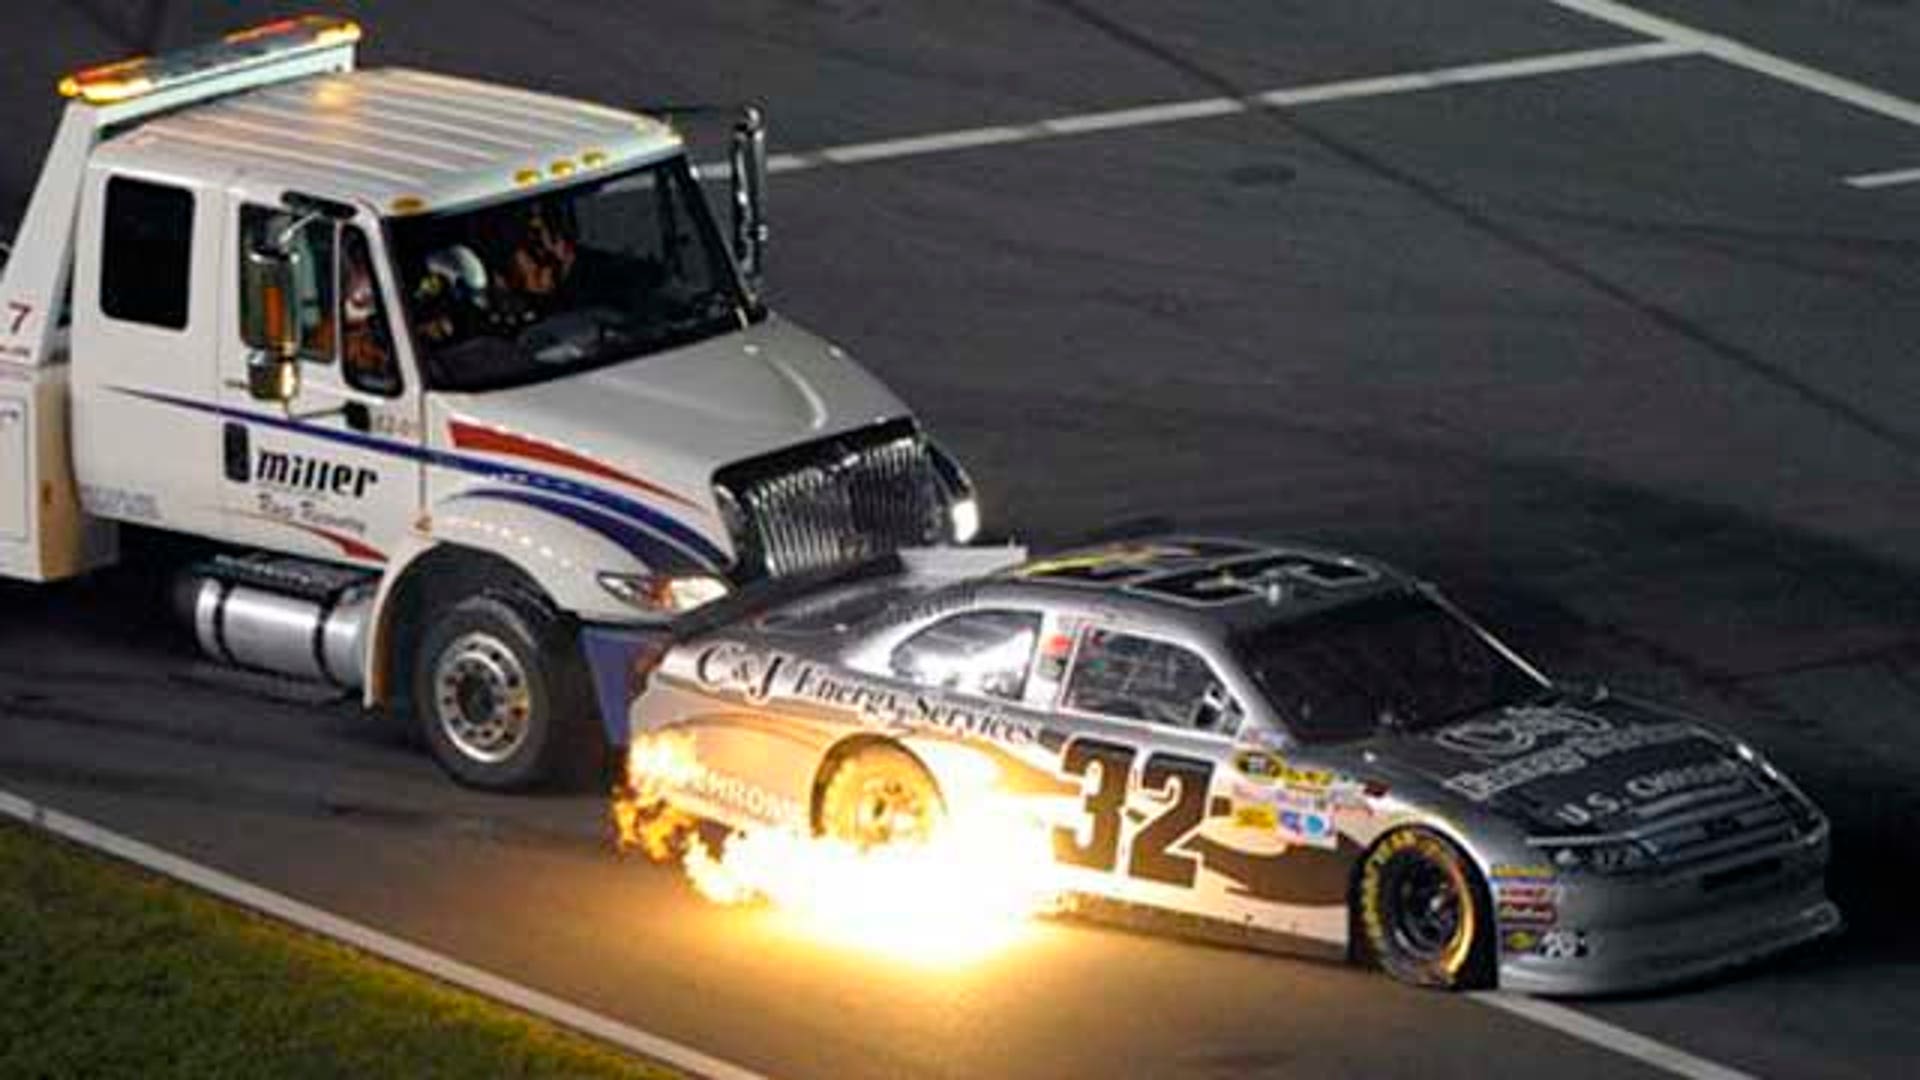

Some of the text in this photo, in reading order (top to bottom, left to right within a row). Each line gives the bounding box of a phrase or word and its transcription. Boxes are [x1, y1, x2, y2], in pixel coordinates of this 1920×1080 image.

[256, 451, 379, 498] miller
[795, 665, 905, 720] Energy
[914, 697, 1035, 744] Services
[1051, 736, 1215, 889] 32
